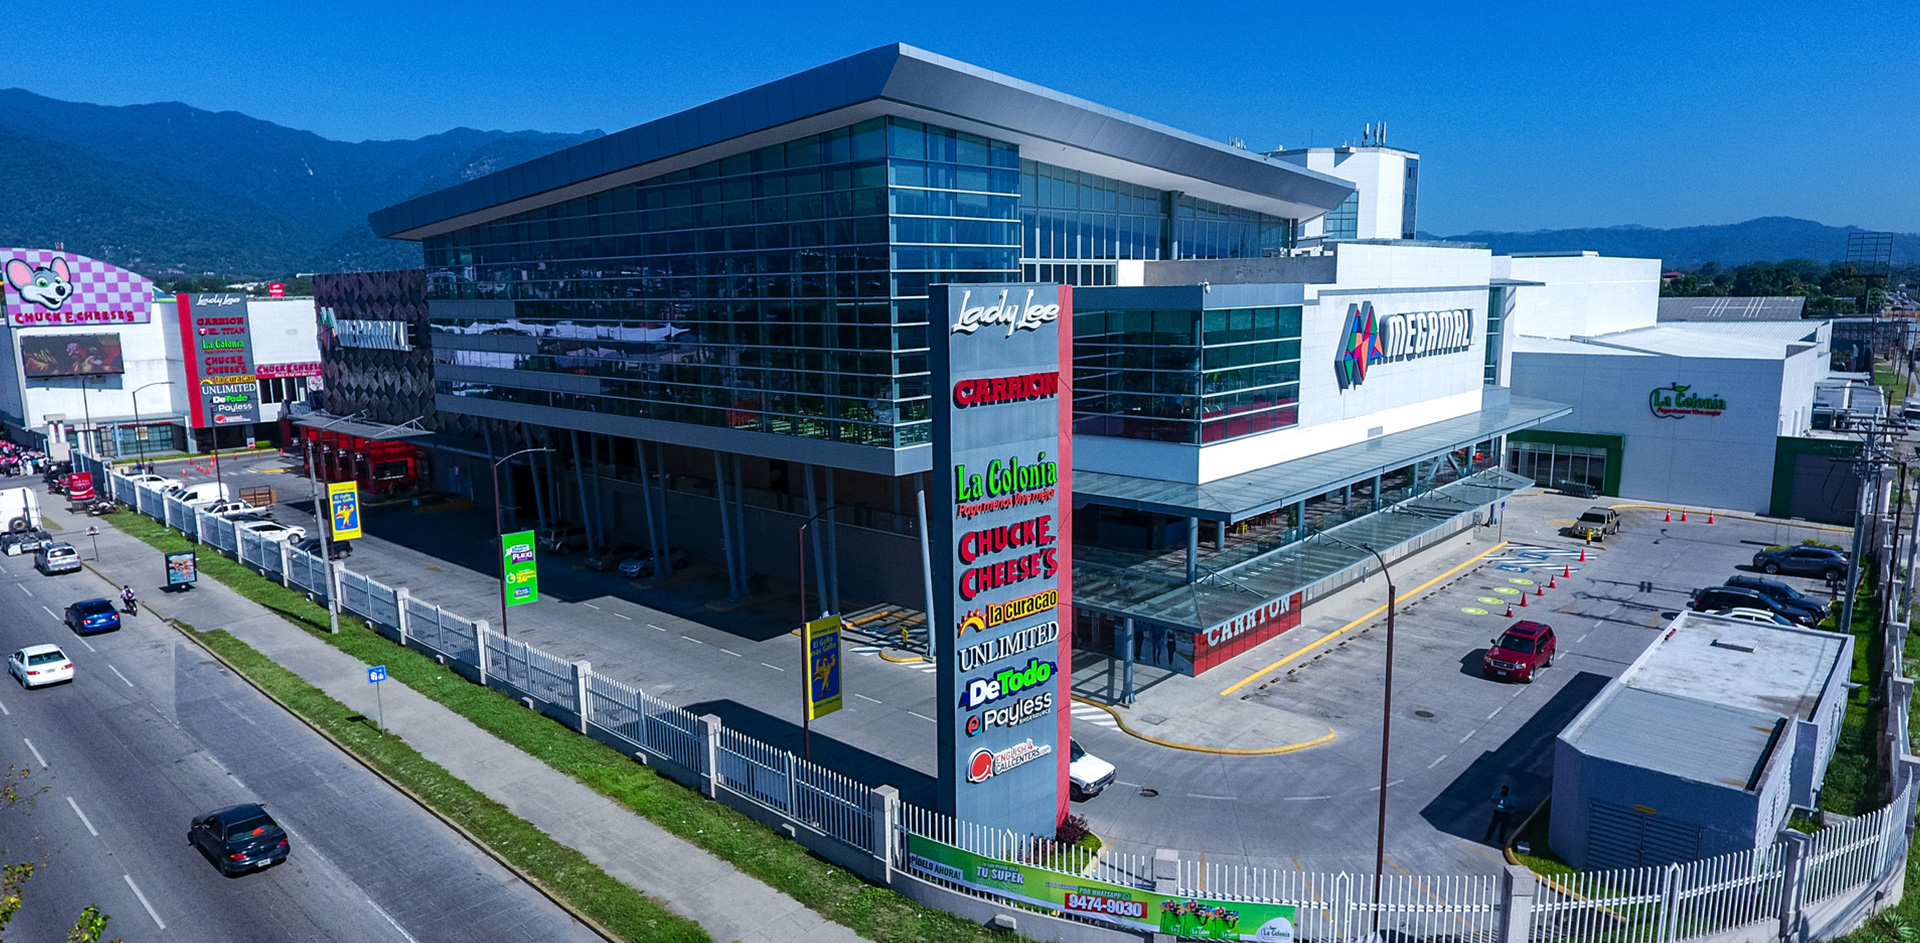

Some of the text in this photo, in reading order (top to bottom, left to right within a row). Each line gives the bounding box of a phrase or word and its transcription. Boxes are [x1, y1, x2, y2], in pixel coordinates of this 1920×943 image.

[15, 311, 61, 324] CHUCK
[77, 309, 135, 322] CHEESE'S
[197, 317, 244, 326] CARRION
[952, 289, 1060, 339] Lady Lee
[203, 340, 213, 349] La
[1386, 308, 1477, 358] MEGAMALL
[202, 384, 256, 395] UNLIMITED
[955, 372, 1059, 406] CARRION
[1654, 391, 1726, 410] La Colonia
[957, 452, 1058, 502] La Colonia
[960, 518, 1035, 564] CHUCK
[960, 548, 1058, 599] CHEESE'S
[988, 590, 1058, 625] la curacao
[960, 621, 1060, 671] UNLIMITED
[969, 660, 1050, 707] DeTodo
[984, 692, 1052, 727] Payless
[996, 745, 1026, 765] ENGLISH
[911, 855, 961, 880] PÍDELO AHORA!
[977, 866, 1024, 884] TU SUPER
[1069, 893, 1142, 918] 9474-9030
[1092, 889, 1122, 899] WHATSAPP
